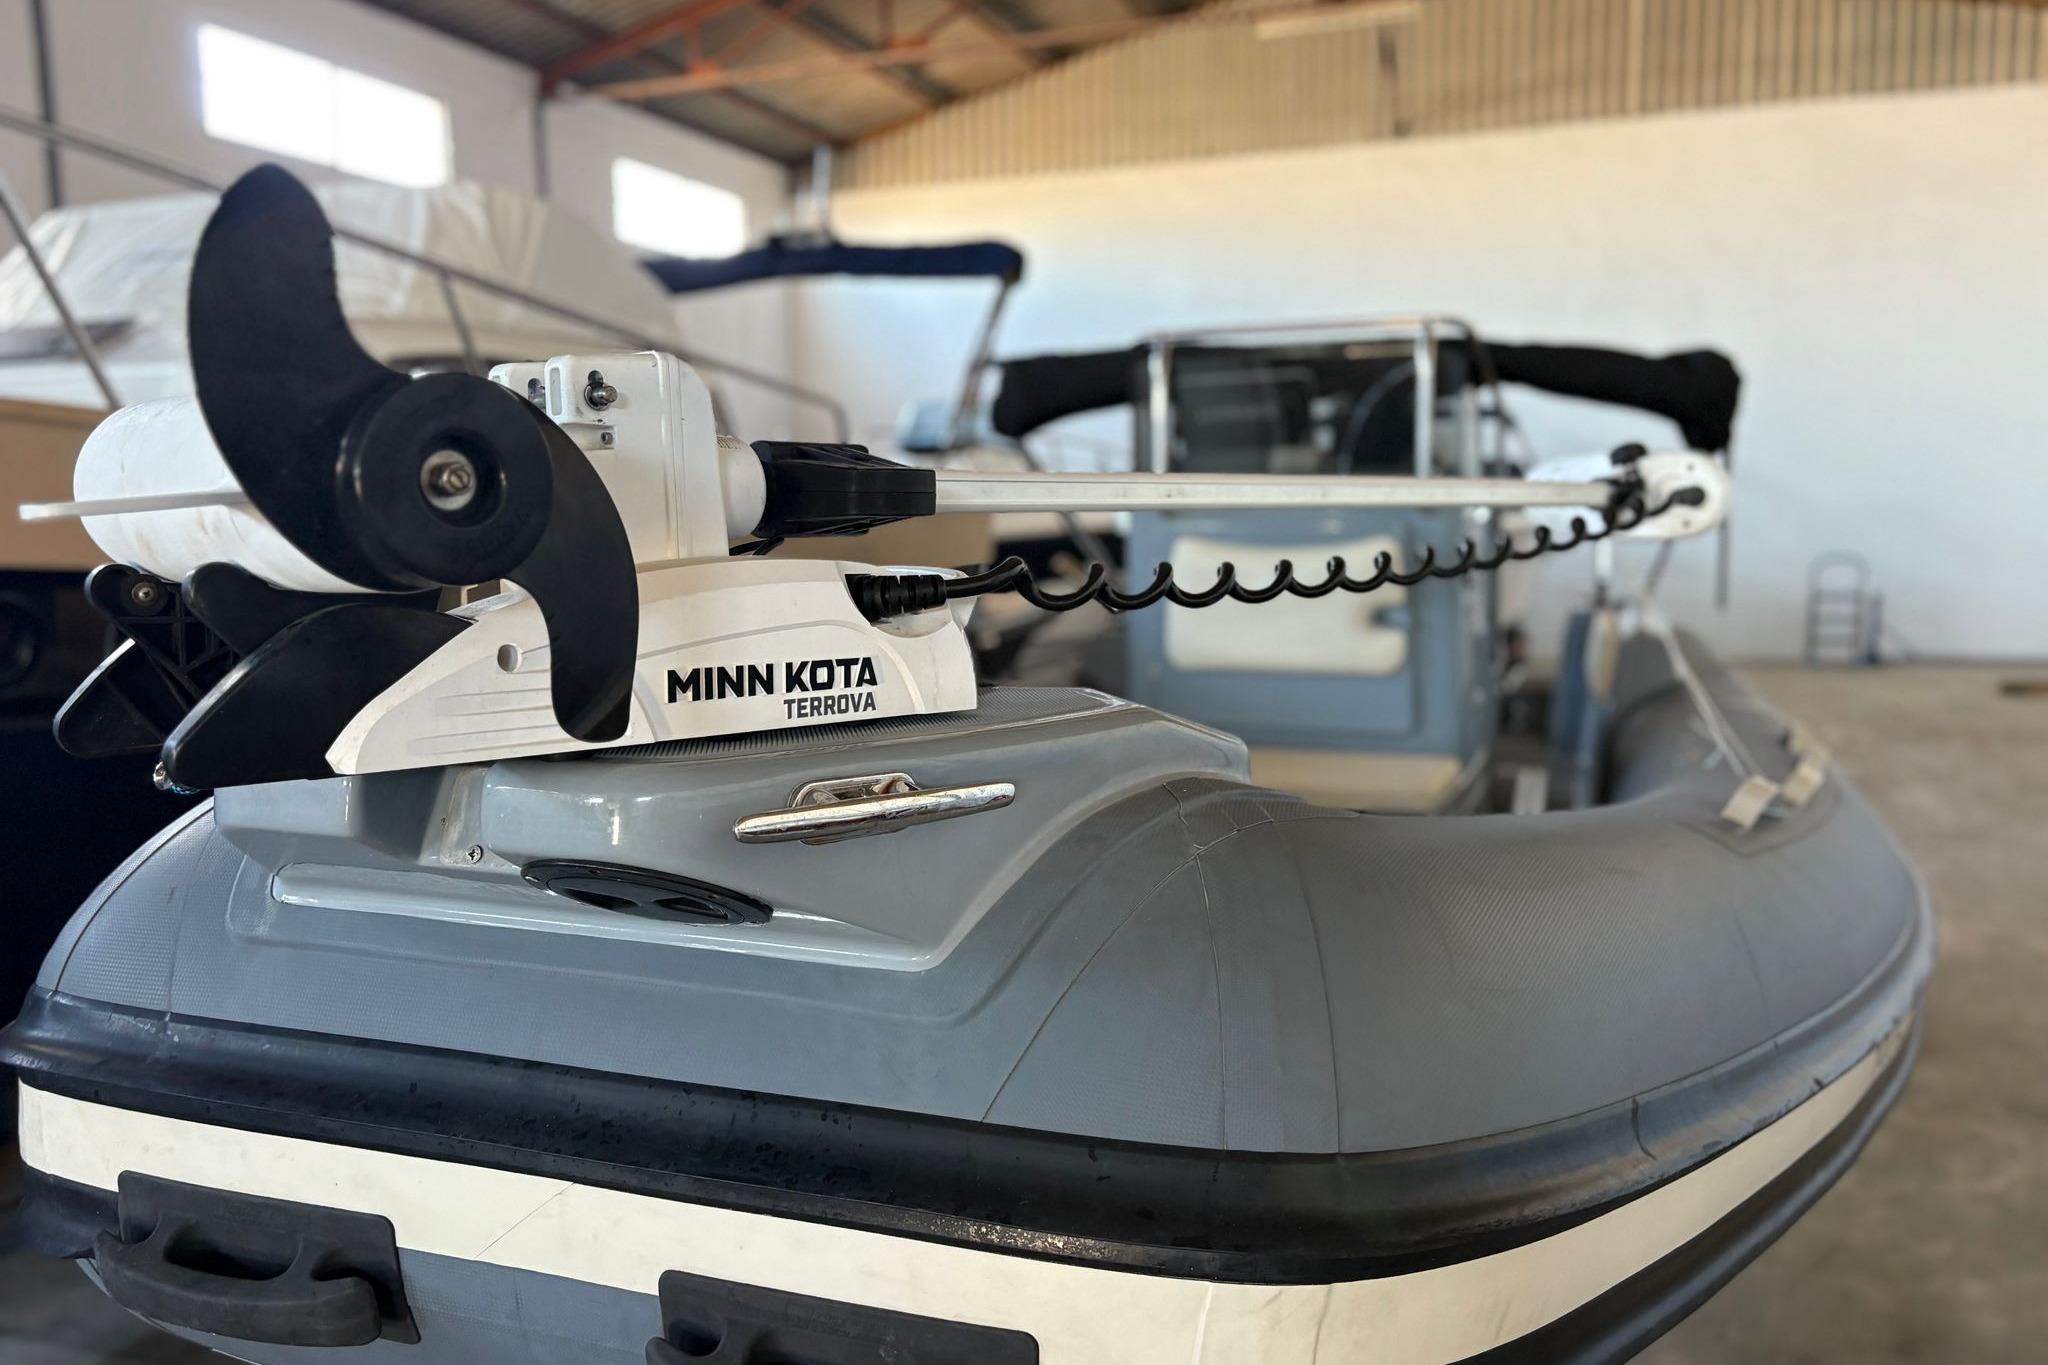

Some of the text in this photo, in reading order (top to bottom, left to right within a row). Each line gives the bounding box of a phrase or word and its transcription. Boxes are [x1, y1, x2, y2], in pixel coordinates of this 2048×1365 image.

[667, 657, 878, 703] MINN KOTA
[784, 692, 877, 720] TERROVA
